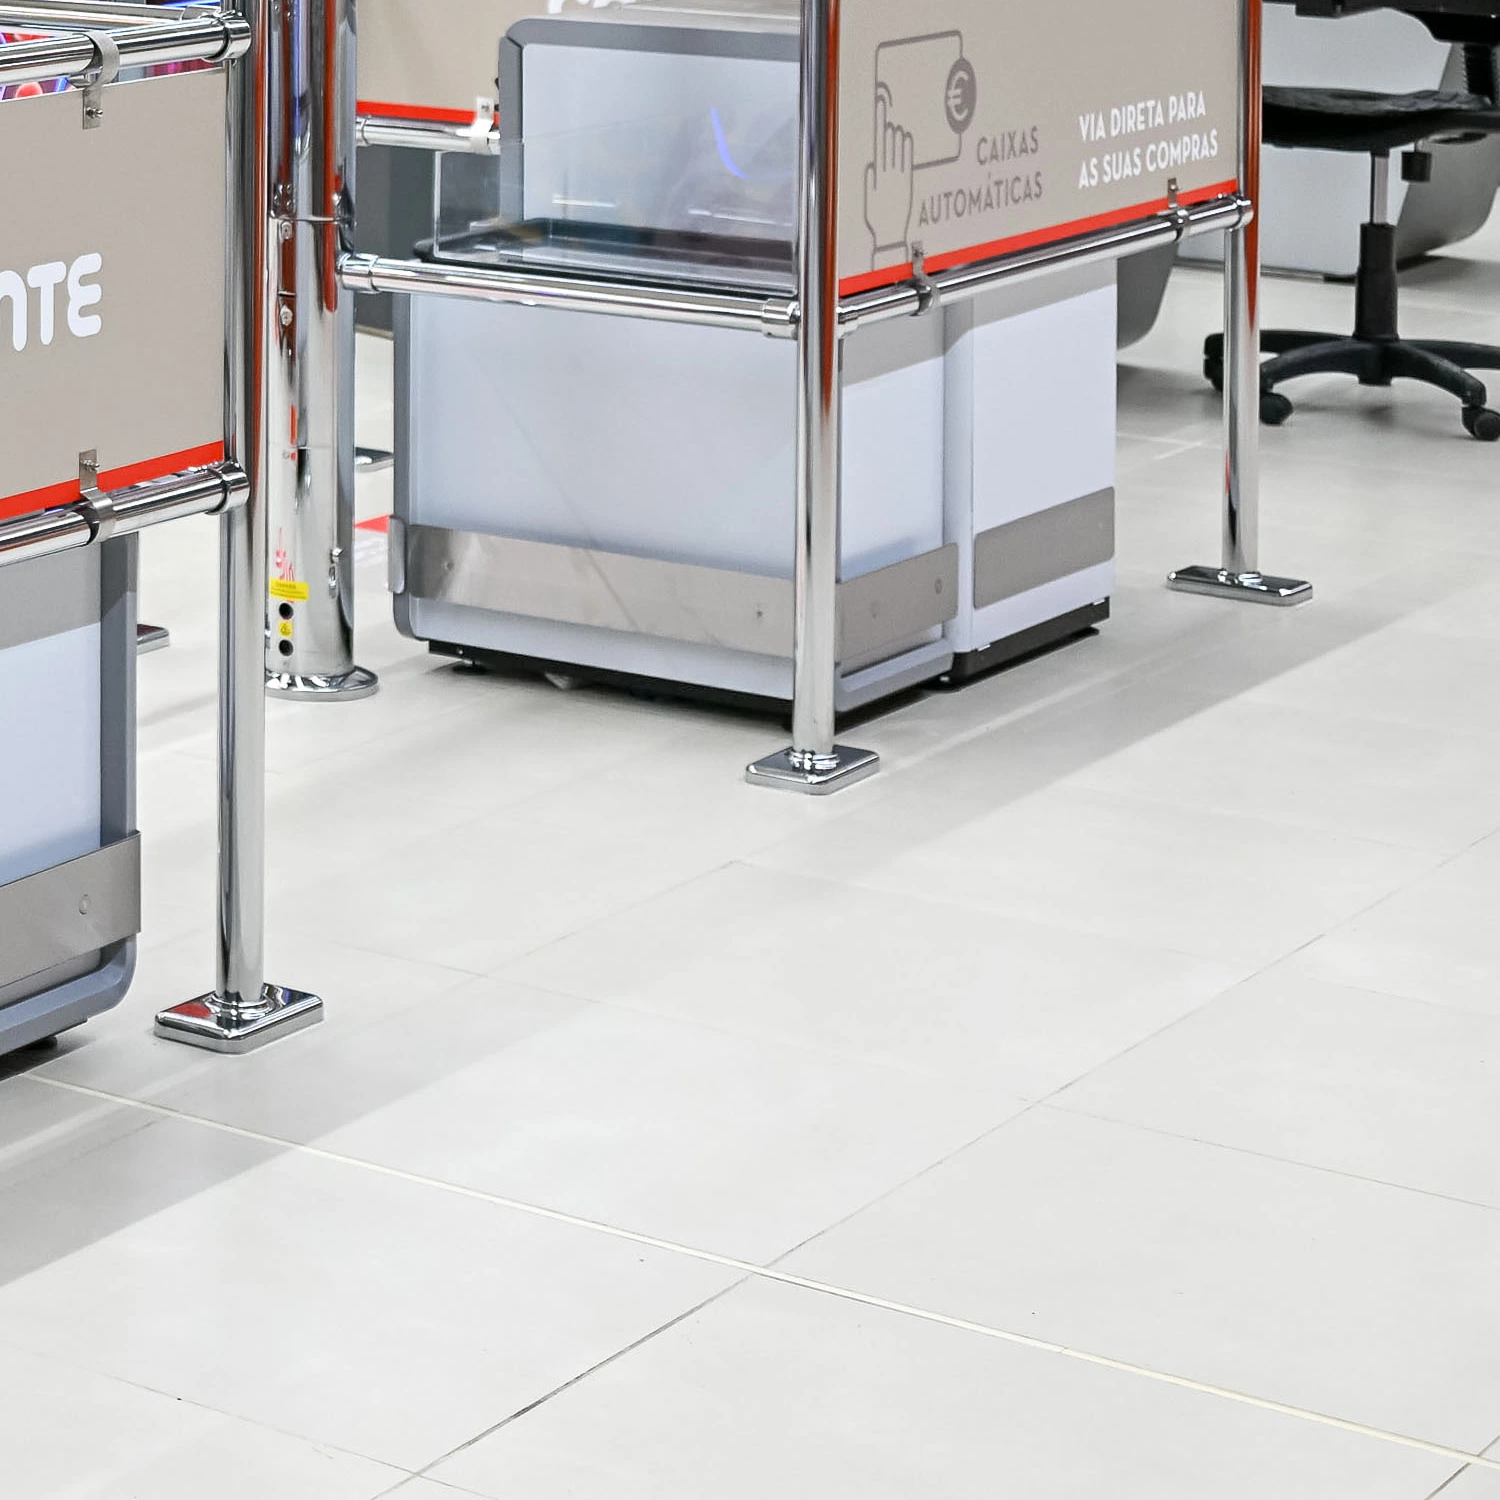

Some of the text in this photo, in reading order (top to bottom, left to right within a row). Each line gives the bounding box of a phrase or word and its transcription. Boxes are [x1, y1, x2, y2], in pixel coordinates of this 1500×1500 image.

[1079, 90, 1207, 143] VIA DIRETA PARA
[976, 125, 1039, 167] CAIXAS
[1078, 128, 1219, 190] AS SUAS COMPRAS
[918, 172, 1043, 229] AUTOMÁTICAS
